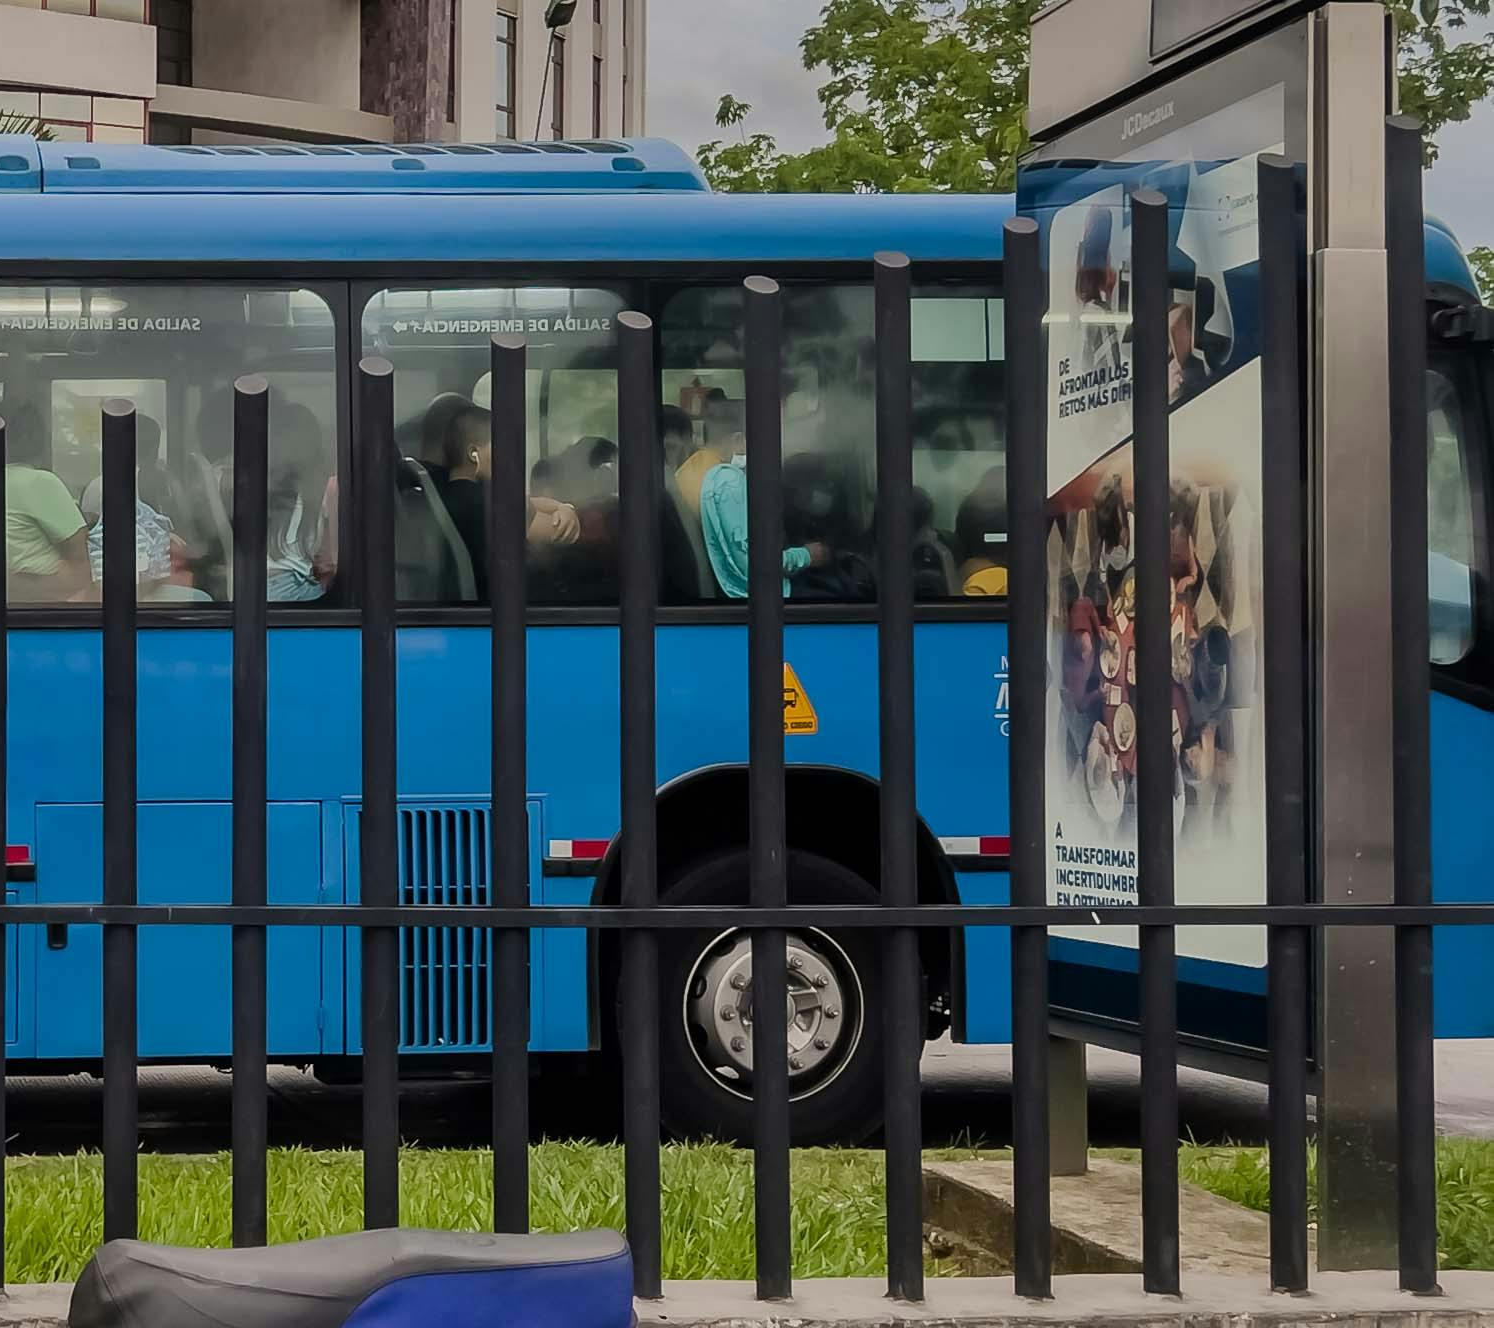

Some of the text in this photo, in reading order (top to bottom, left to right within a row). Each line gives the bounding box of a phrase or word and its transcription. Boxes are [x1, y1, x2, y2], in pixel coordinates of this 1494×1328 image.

[1058, 357, 1070, 377] DE
[1058, 361, 1129, 397] AFRONTAR LOS
[1058, 395, 1086, 419] RETOS
[1055, 821, 1064, 840] A
[1055, 844, 1136, 869] TRANSFORMAR
[1056, 891, 1071, 907] EN
